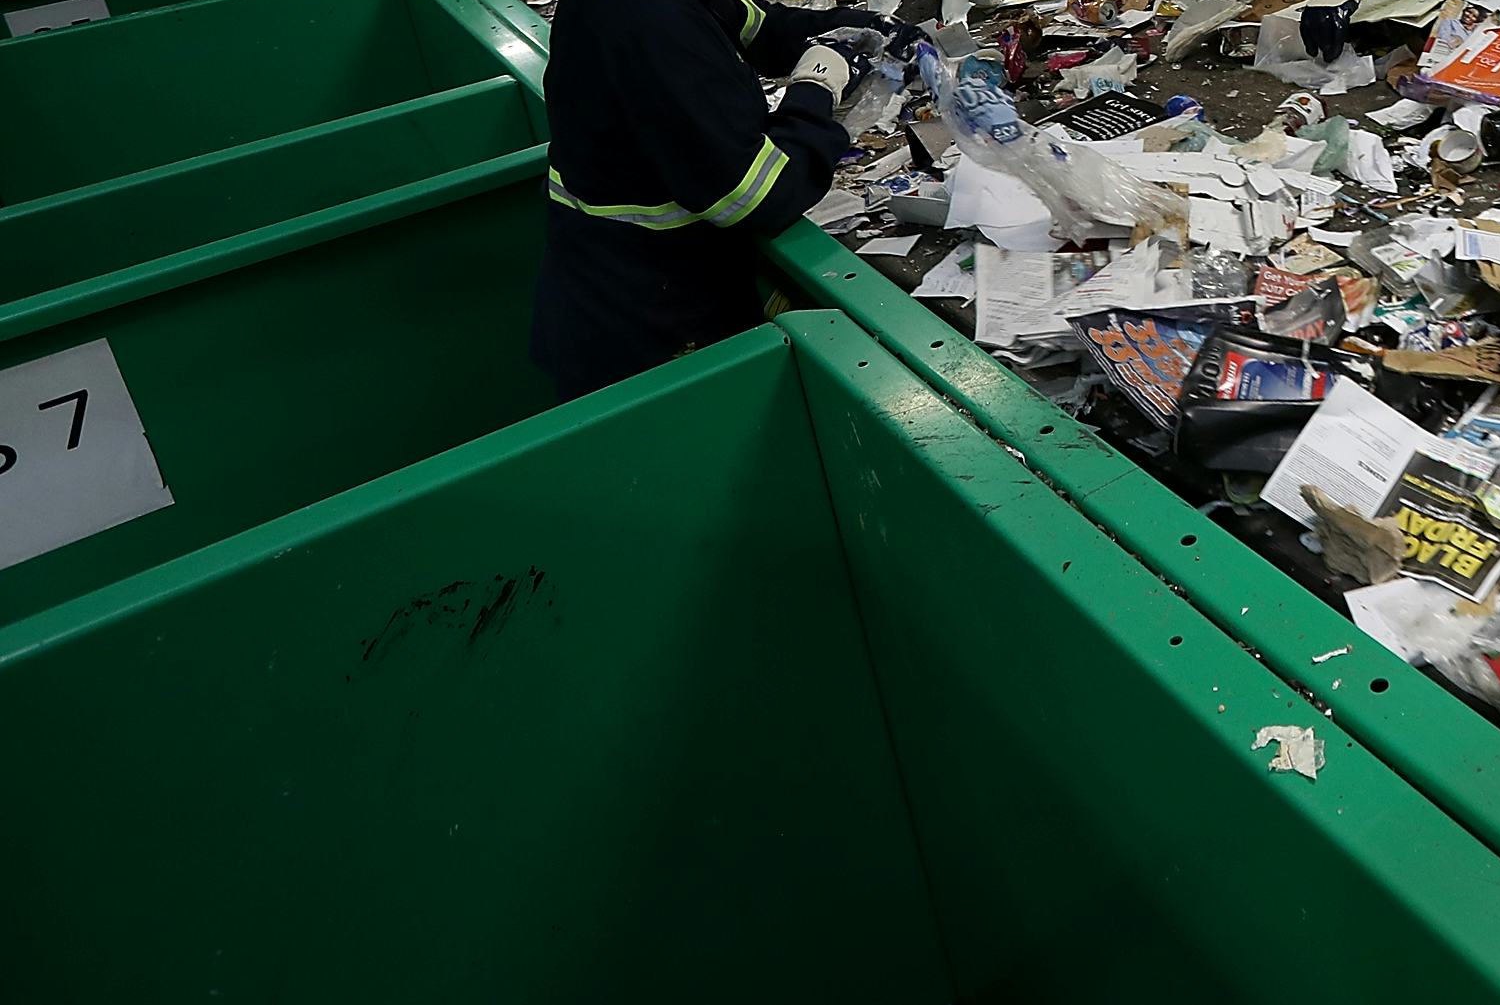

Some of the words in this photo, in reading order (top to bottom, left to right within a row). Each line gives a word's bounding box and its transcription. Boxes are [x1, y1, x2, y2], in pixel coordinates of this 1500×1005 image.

[812, 63, 828, 74] M
[1263, 270, 1283, 283] Get
[38, 388, 89, 451] 7
[1402, 534, 1484, 580] BLAC
